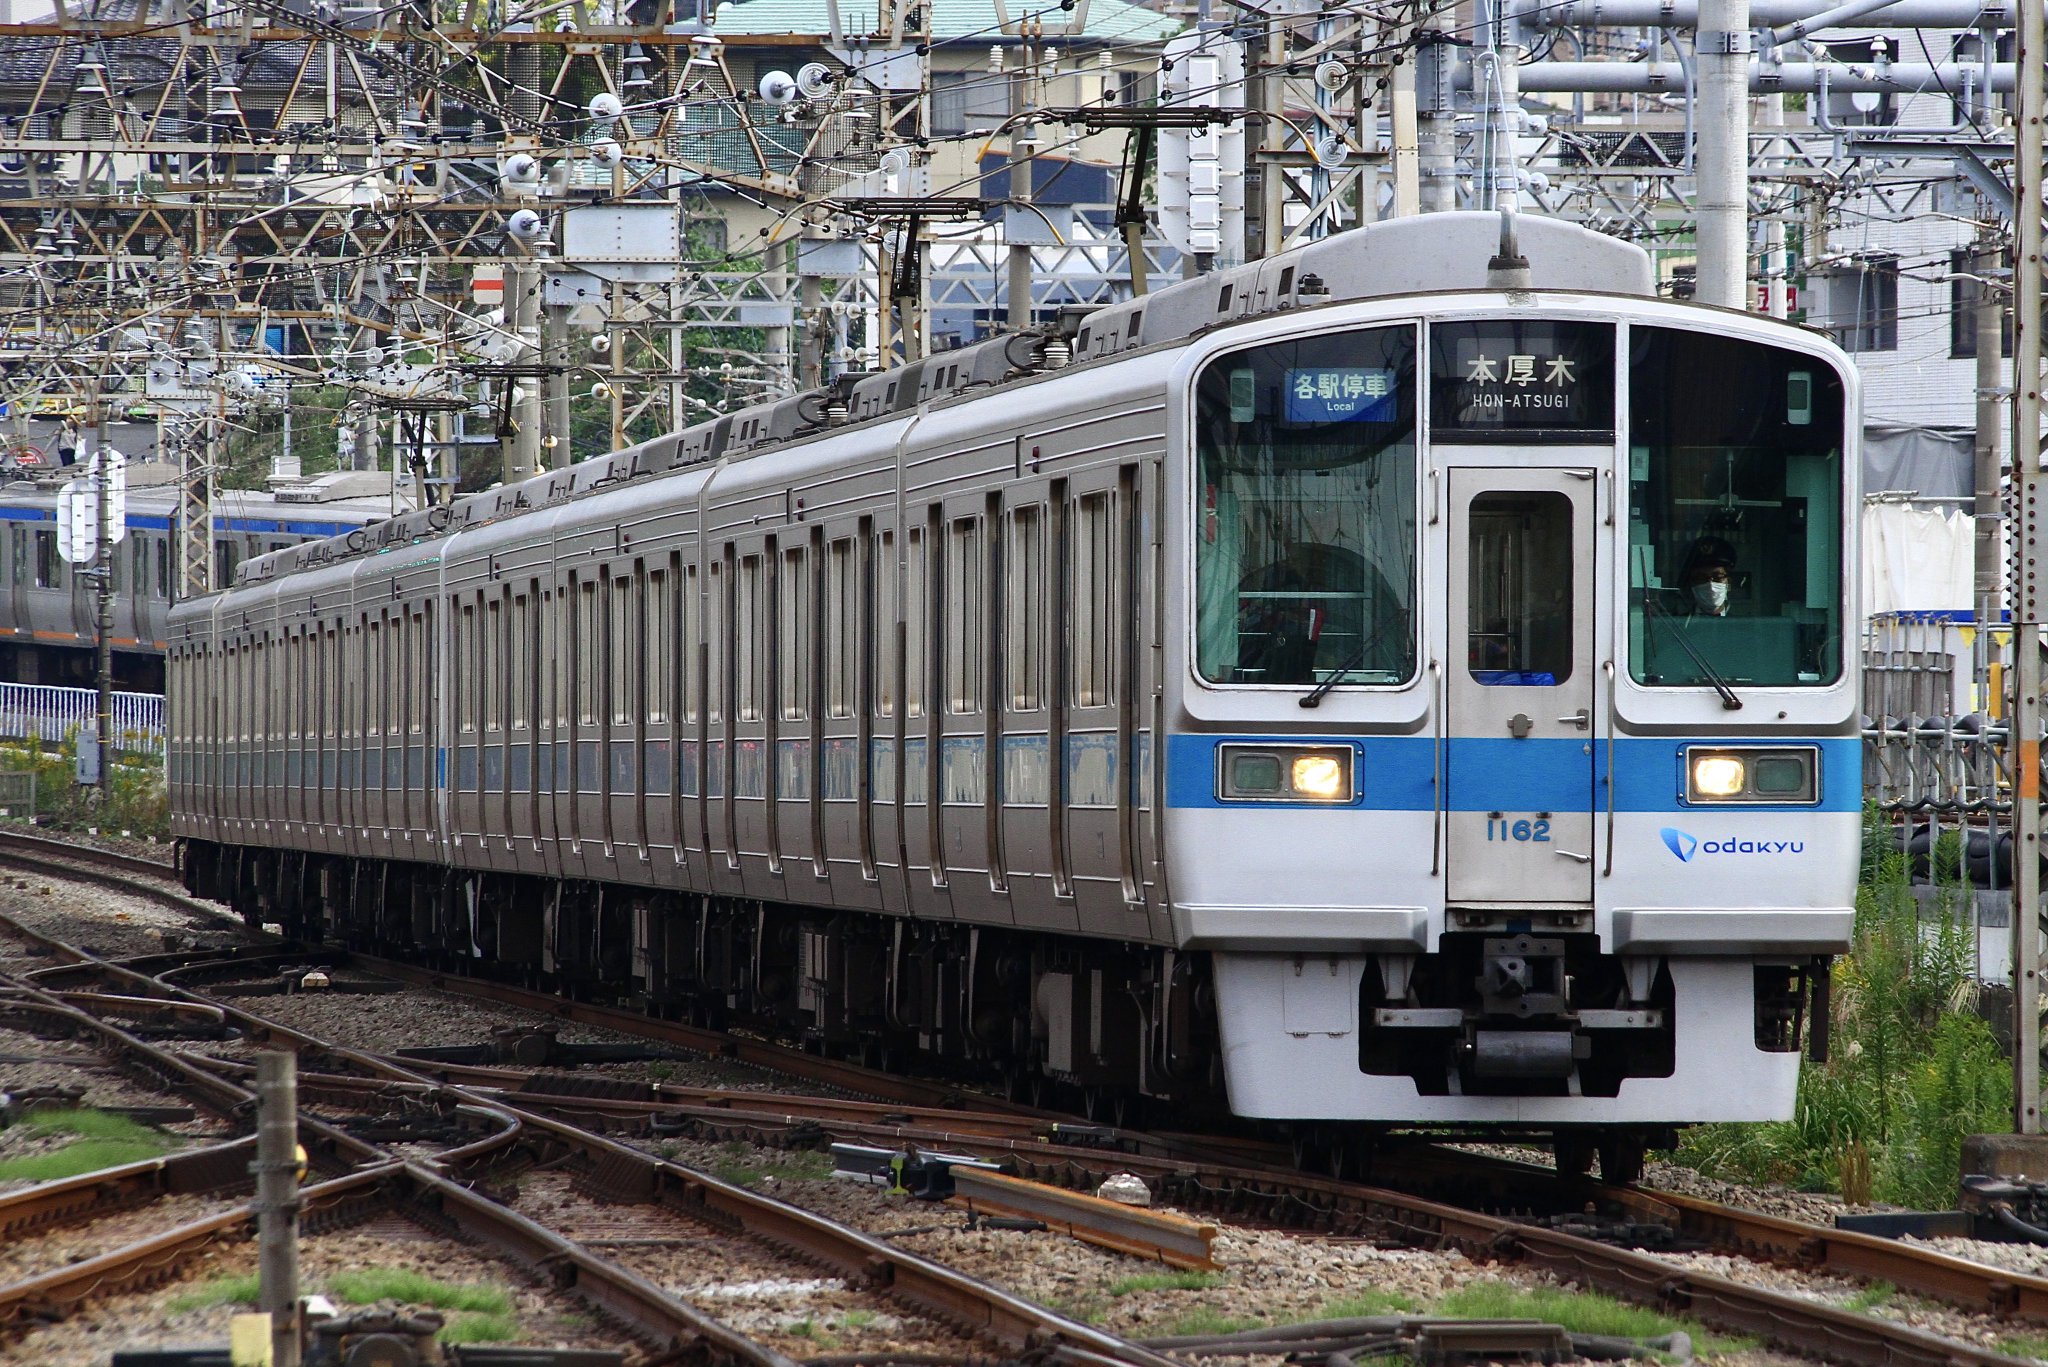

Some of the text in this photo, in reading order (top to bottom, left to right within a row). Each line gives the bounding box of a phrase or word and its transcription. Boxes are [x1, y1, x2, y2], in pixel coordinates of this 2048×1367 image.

[1466, 354, 1576, 387] 本厚木
[1294, 373, 1388, 399] 各駅停車
[1327, 402, 1354, 411] Local
[1473, 394, 1569, 408] HON-ATSUGI
[1487, 820, 1550, 841] 1162
[1703, 837, 1804, 854] odakyu
